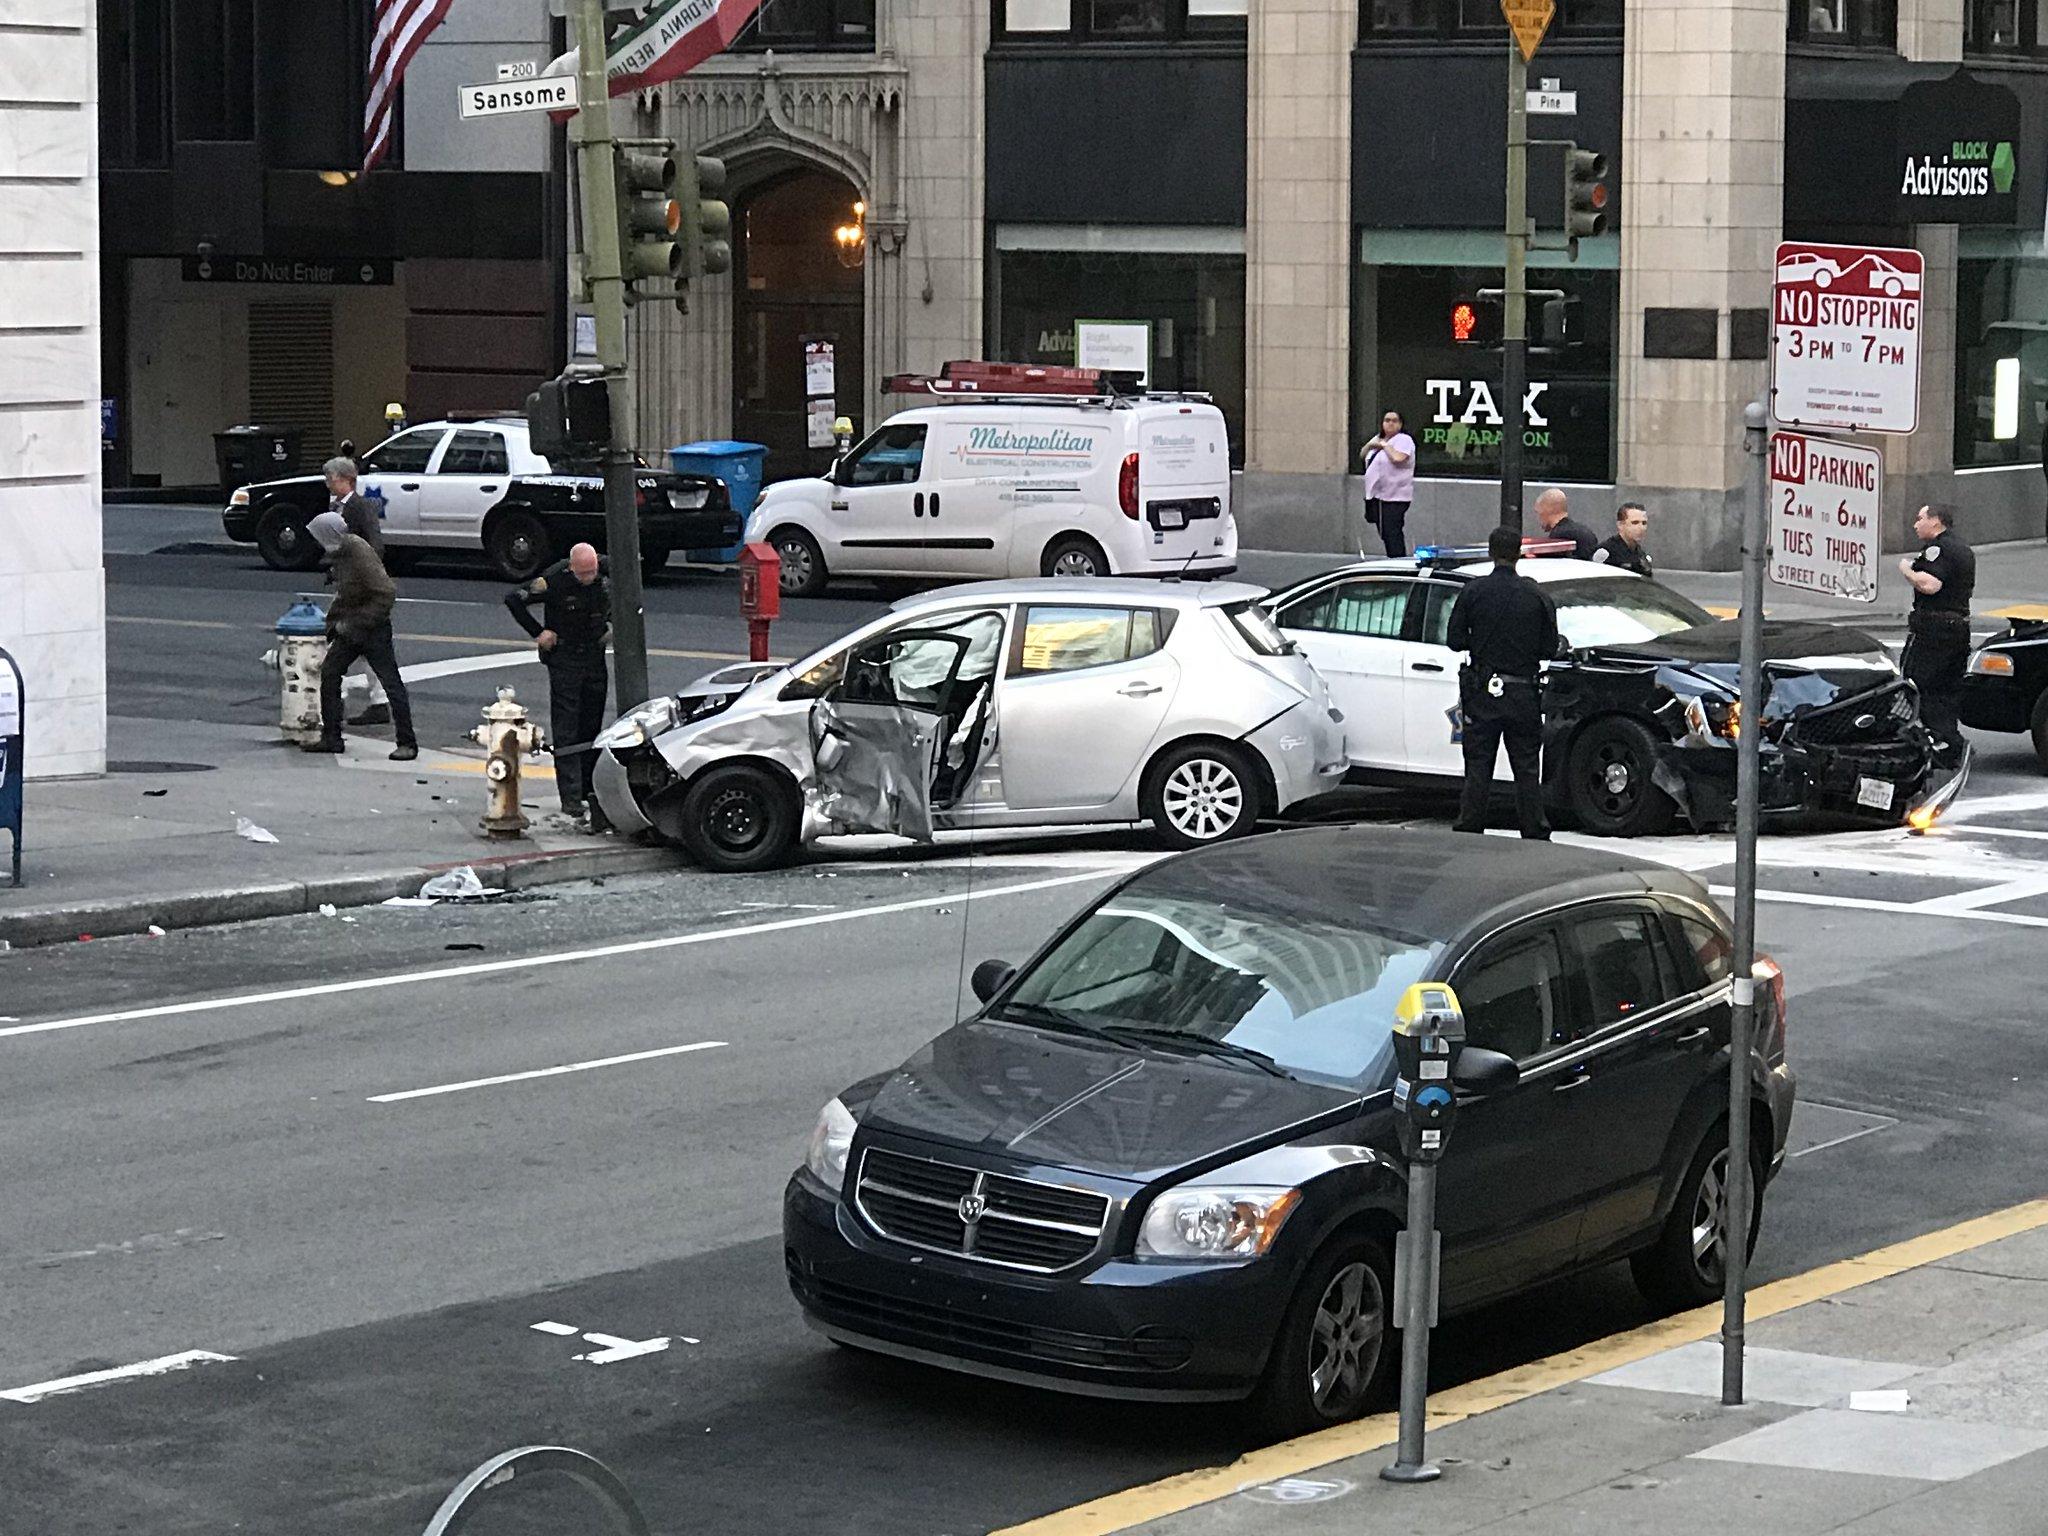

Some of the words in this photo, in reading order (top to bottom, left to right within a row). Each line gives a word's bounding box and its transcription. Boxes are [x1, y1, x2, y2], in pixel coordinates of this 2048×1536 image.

[511, 63, 533, 77] 200
[474, 86, 566, 110] Sansome
[1540, 95, 1561, 109] Pine
[1952, 141, 1988, 160] BLOCK
[1901, 155, 1988, 196] Advisors
[235, 262, 257, 280] Do
[262, 262, 290, 280] Not
[294, 262, 333, 282] Enter
[1780, 289, 1813, 324] NO
[1820, 297, 1915, 330] STOPPING
[1841, 342, 1852, 353] TO
[969, 427, 1093, 456] Metropolitan
[966, 458, 1018, 467] ELECTRICAL
[1021, 459, 1092, 469] CONSTRUCTION
[1775, 437, 1801, 479] NO
[1809, 453, 1875, 492] PARKING
[1821, 511, 1830, 523] TO
[1782, 528, 1813, 557] TUES
[1826, 537, 1866, 566] THURS
[1778, 564, 1815, 586] STREET
